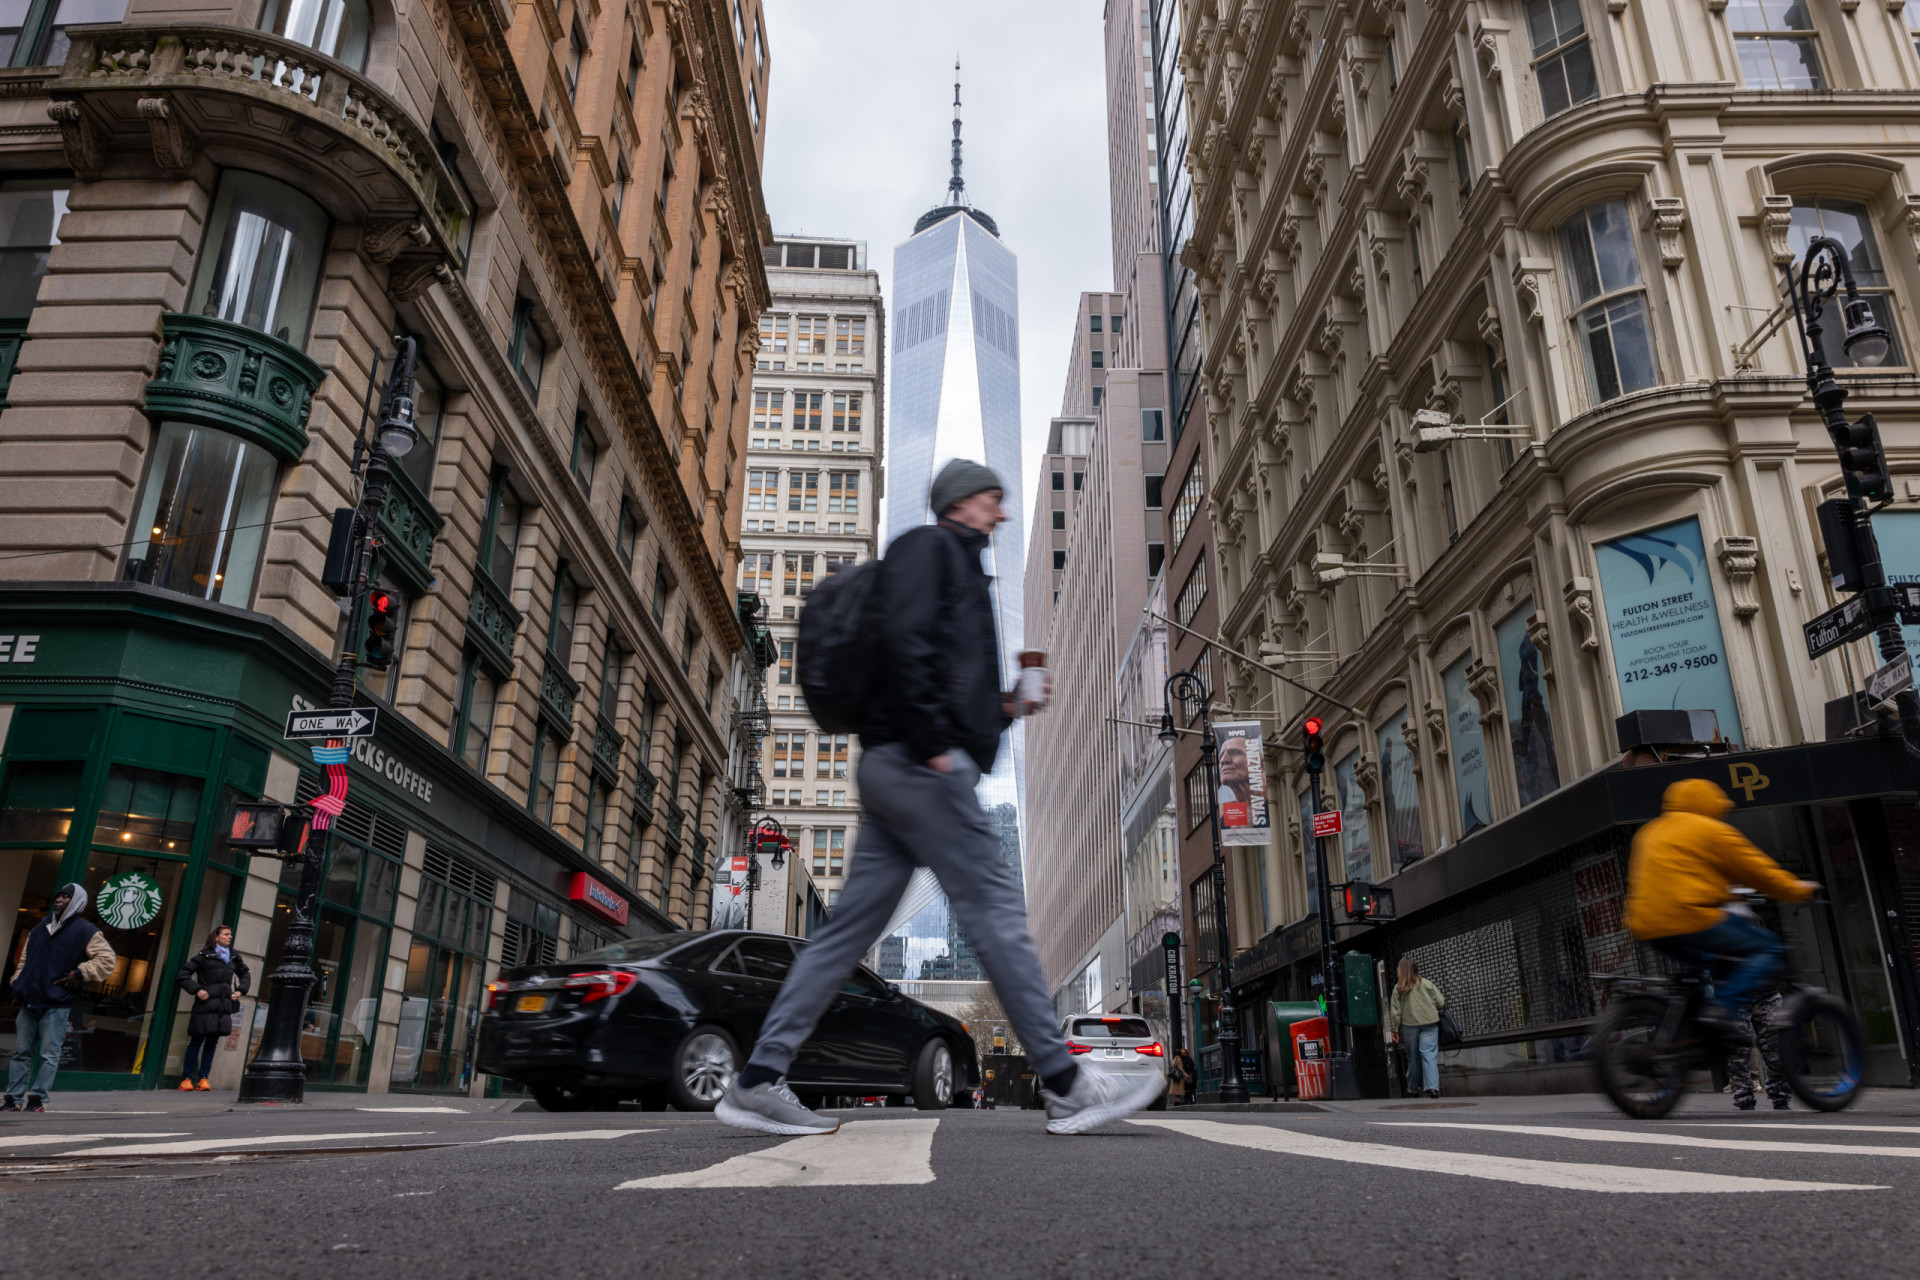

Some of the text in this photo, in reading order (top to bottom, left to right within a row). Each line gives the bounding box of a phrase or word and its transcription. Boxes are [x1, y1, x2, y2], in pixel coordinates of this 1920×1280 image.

[1622, 592, 1693, 616] FULTON STREET
[1612, 615, 1648, 630] HEALTH
[1620, 614, 1704, 638] FULTONSTREETHEALTH.COM
[1809, 617, 1845, 651] Fulton St
[1629, 644, 1708, 667] APPOINTMENT TODAY
[1643, 640, 1688, 656] BOOK YOUR
[1624, 653, 1718, 683] 212-349-9500
[1874, 664, 1906, 694] ONE WAY
[299, 716, 362, 730] ONE WAY
[1461, 746, 1480, 764] MEDICAL
[385, 757, 433, 804] COFFEE
[1244, 738, 1267, 826] STAY AMAZING
[1167, 949, 1178, 994] CBD KRATOM
